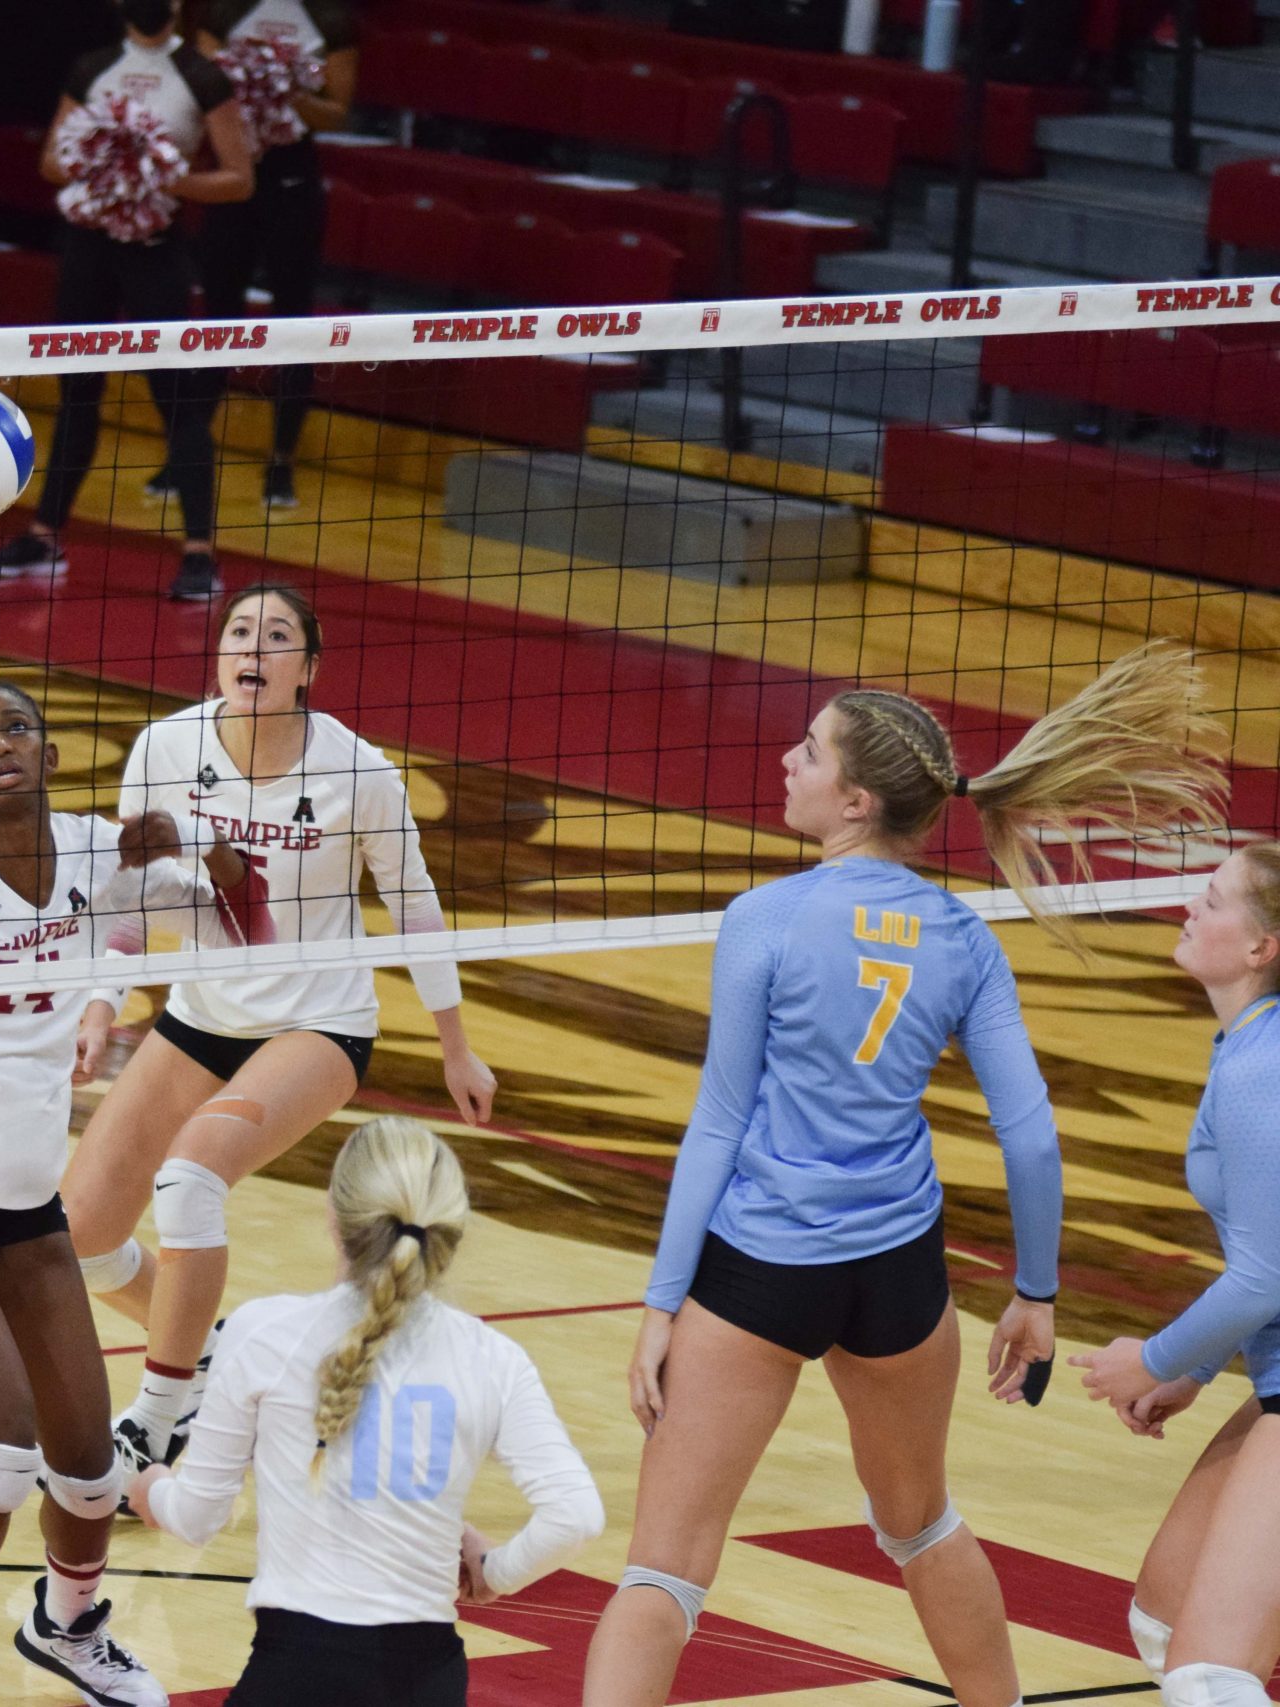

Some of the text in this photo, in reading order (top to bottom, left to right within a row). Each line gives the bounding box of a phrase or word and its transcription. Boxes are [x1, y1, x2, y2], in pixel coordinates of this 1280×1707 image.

[782, 296, 1002, 328] TEMPLE OWLS
[1138, 285, 1254, 312] TEMPLE
[28, 325, 268, 357] TEMPLE OWLS
[413, 312, 641, 343] TEMPLE OWLS
[292, 797, 315, 823] A
[853, 905, 921, 948] LIU
[852, 956, 914, 1065] 7
[351, 1382, 457, 1500] 10
